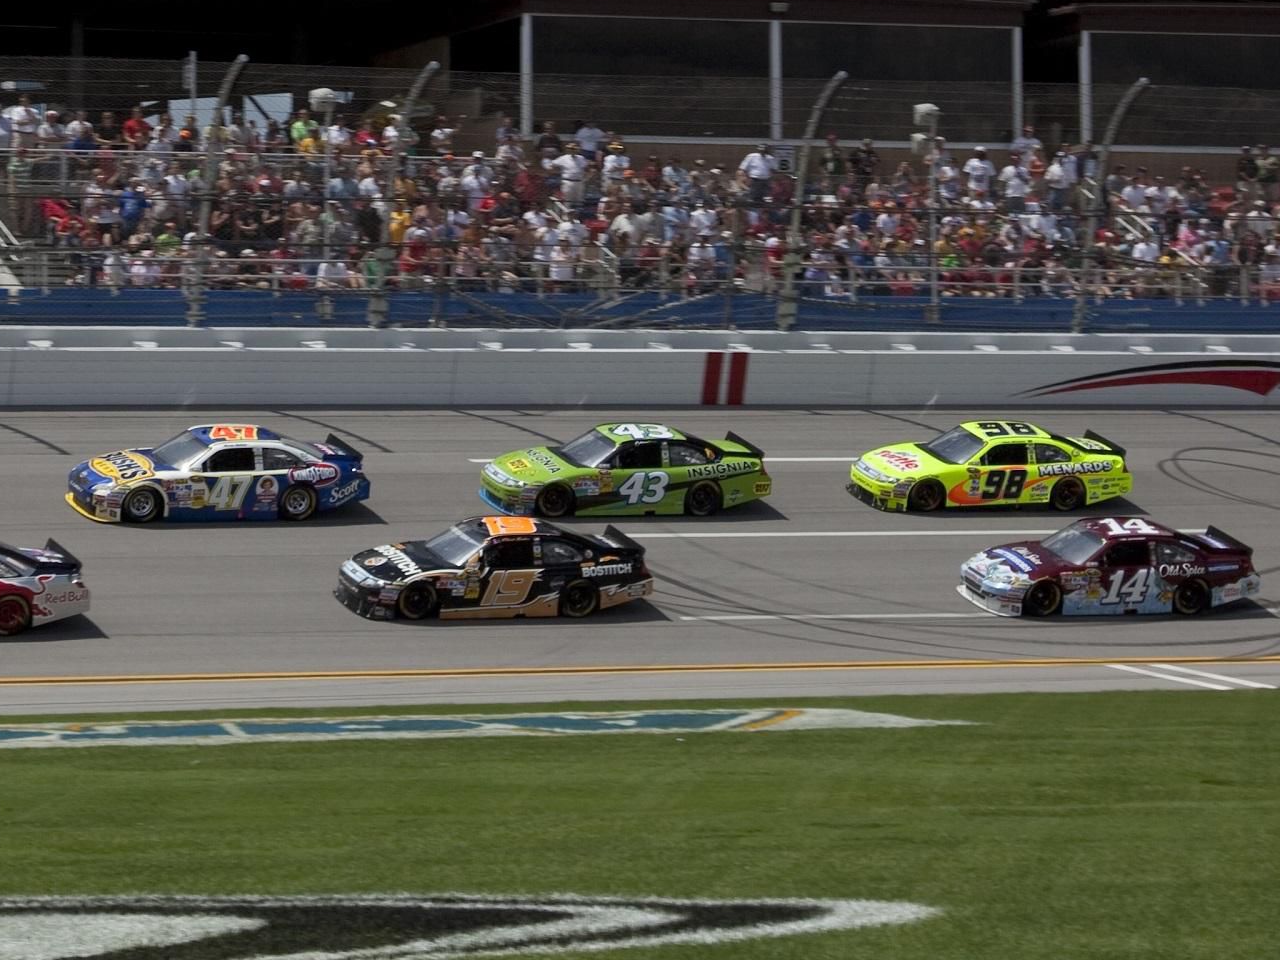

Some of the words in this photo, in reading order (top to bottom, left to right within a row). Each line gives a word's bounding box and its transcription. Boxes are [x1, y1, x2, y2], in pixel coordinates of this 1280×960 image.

[210, 424, 258, 440] 47
[613, 423, 674, 439] 43
[977, 422, 1037, 436] 98
[687, 461, 752, 478] INSIGNIA
[1039, 460, 1113, 476] MENARDS
[208, 475, 253, 511] 47
[329, 480, 360, 503] Scott
[619, 471, 669, 504] 43
[981, 470, 1027, 499] 98
[483, 516, 538, 536] 19
[1098, 518, 1160, 536] 14
[373, 544, 422, 576] BOSTITCH
[581, 563, 633, 578] BOSTITCH
[1160, 563, 1180, 578] Old
[1180, 563, 1205, 577] Spice
[481, 569, 544, 606] 19
[1101, 566, 1153, 603] 14
[44, 593, 68, 605] Red
[69, 589, 88, 602] Bull
